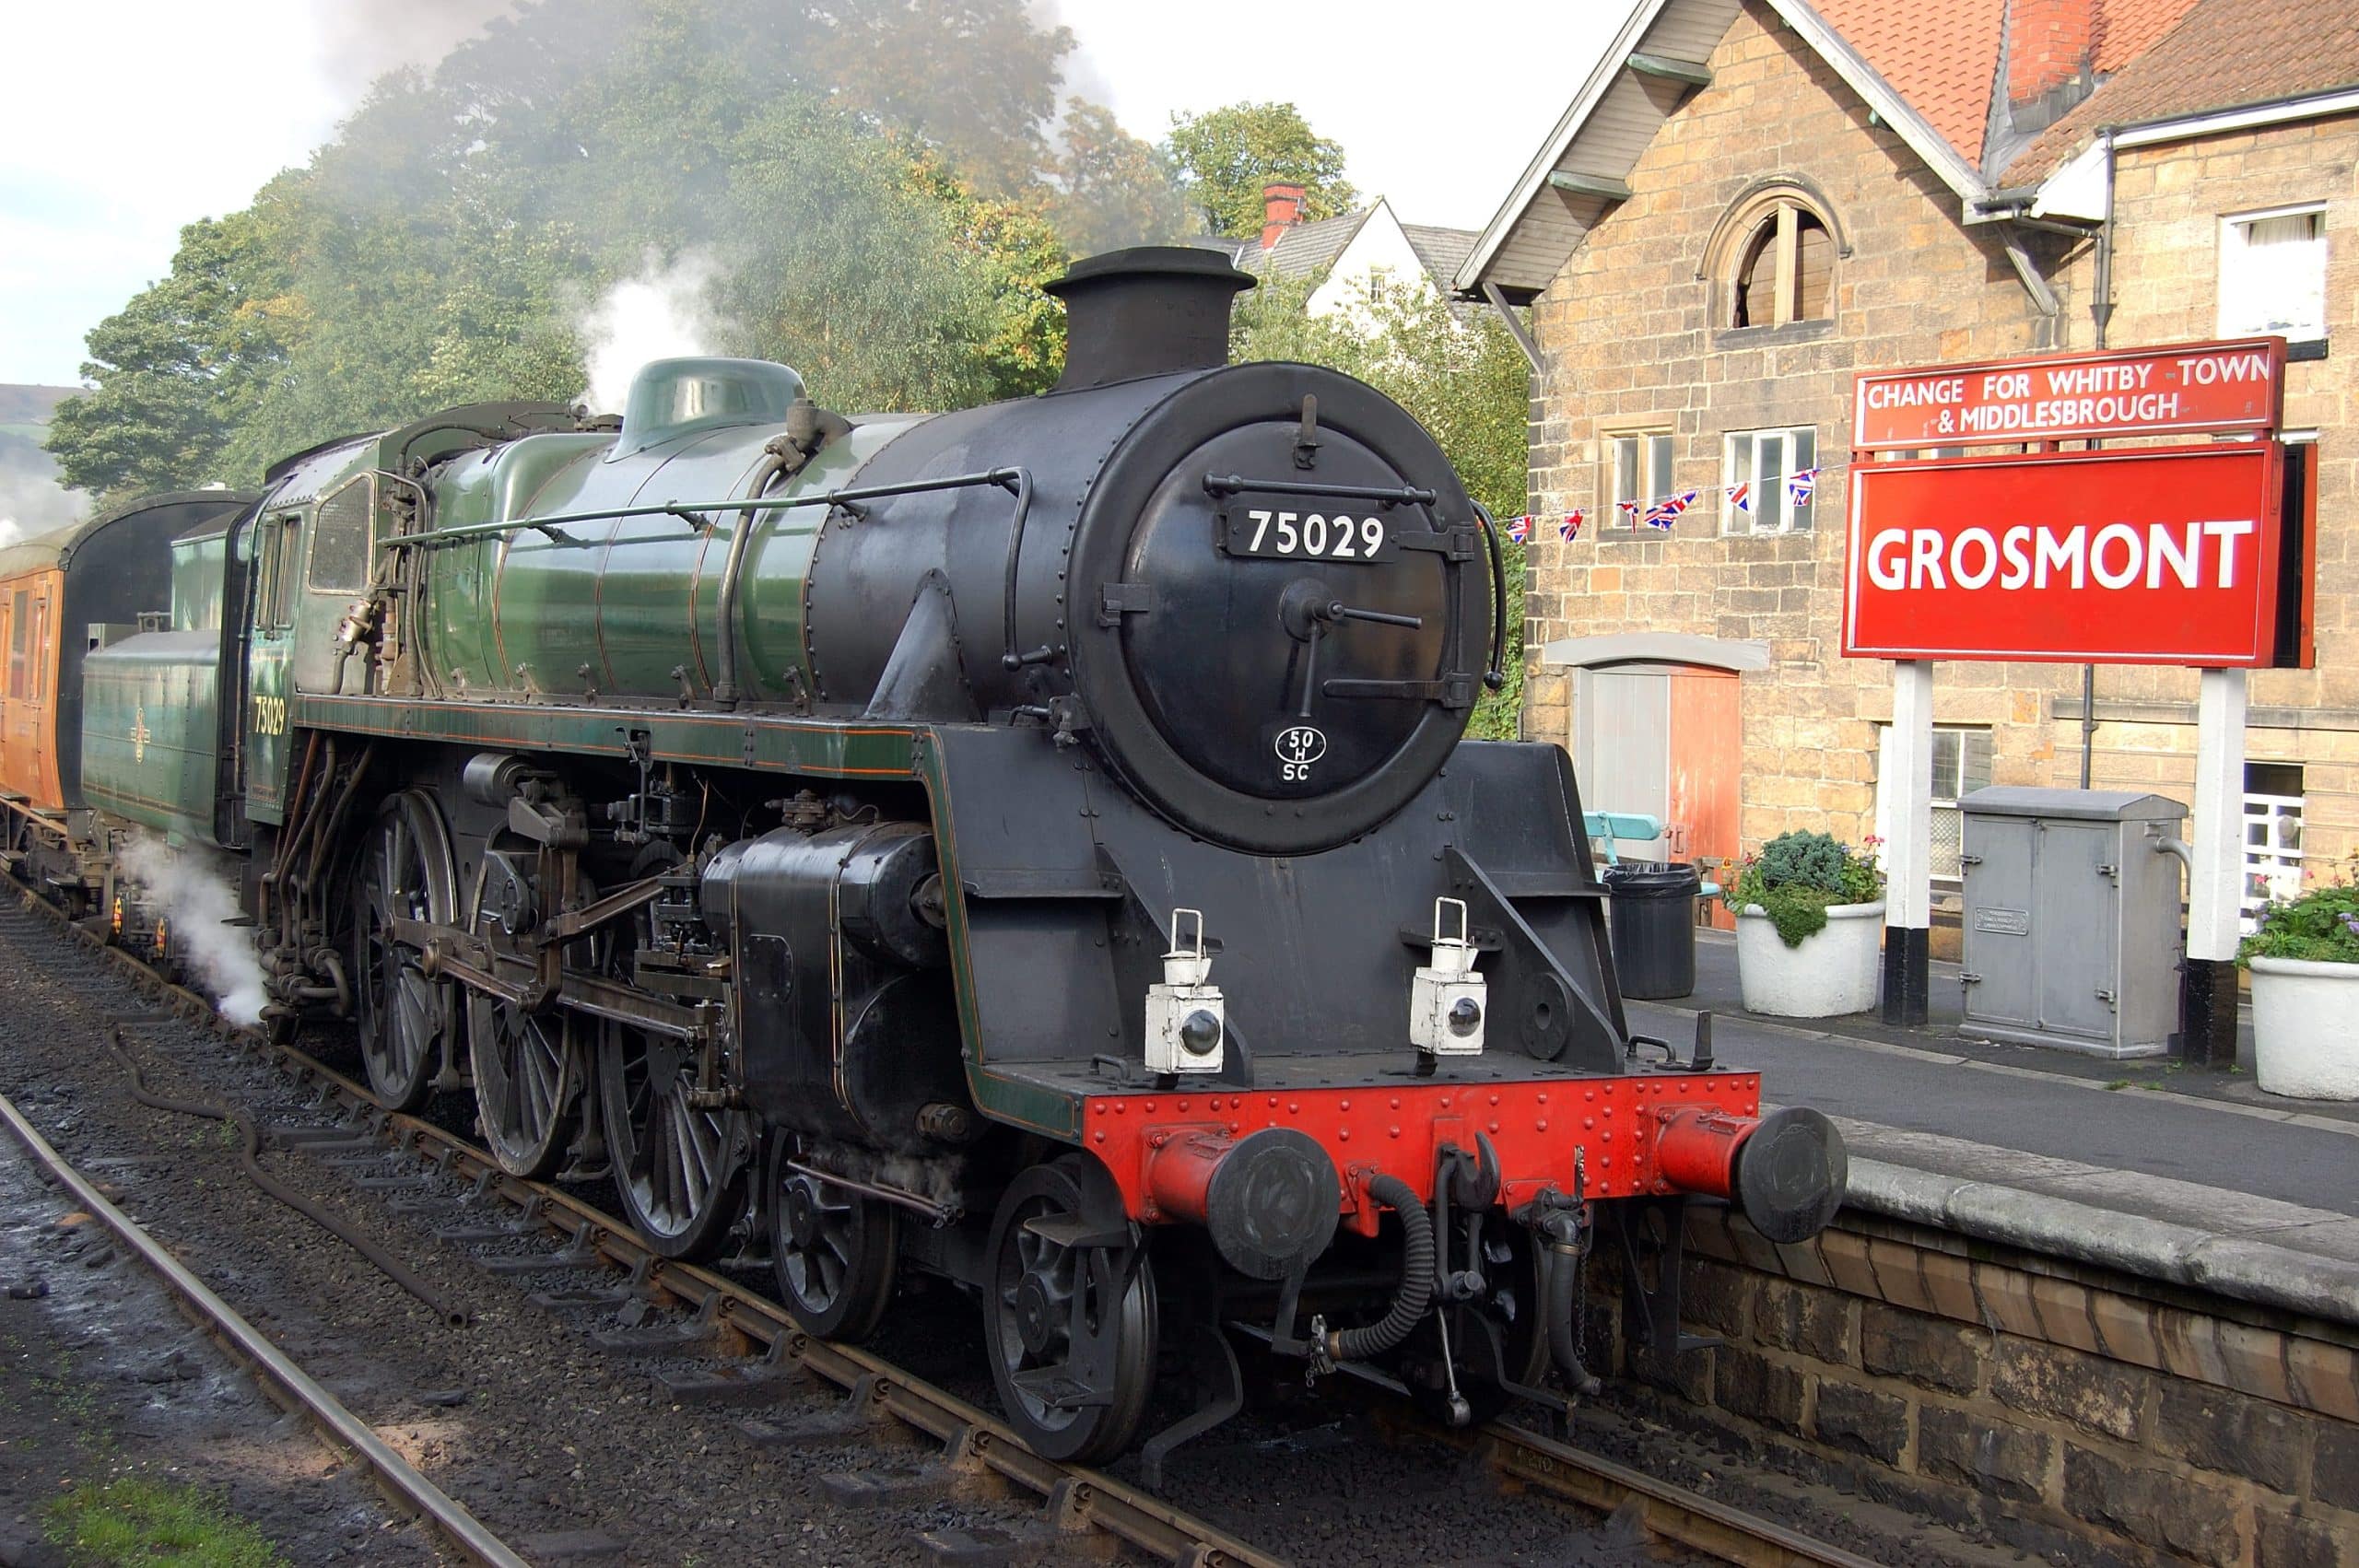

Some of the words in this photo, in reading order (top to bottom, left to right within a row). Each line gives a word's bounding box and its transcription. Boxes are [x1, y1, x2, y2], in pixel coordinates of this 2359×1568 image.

[1868, 379, 1964, 409] CHANGE
[1983, 373, 2030, 401] FOR
[2047, 363, 2154, 396] WHITBY
[2177, 354, 2270, 386] TOWN
[1937, 409, 1954, 434] &
[1959, 392, 2179, 432] MIDDLESBROUGH
[1248, 509, 1384, 558] 75029
[1867, 520, 2254, 591] GROSMONT
[255, 696, 285, 735] 75029
[1289, 731, 1313, 748] 50
[1295, 747, 1306, 761] H
[1283, 764, 1309, 780] SC
